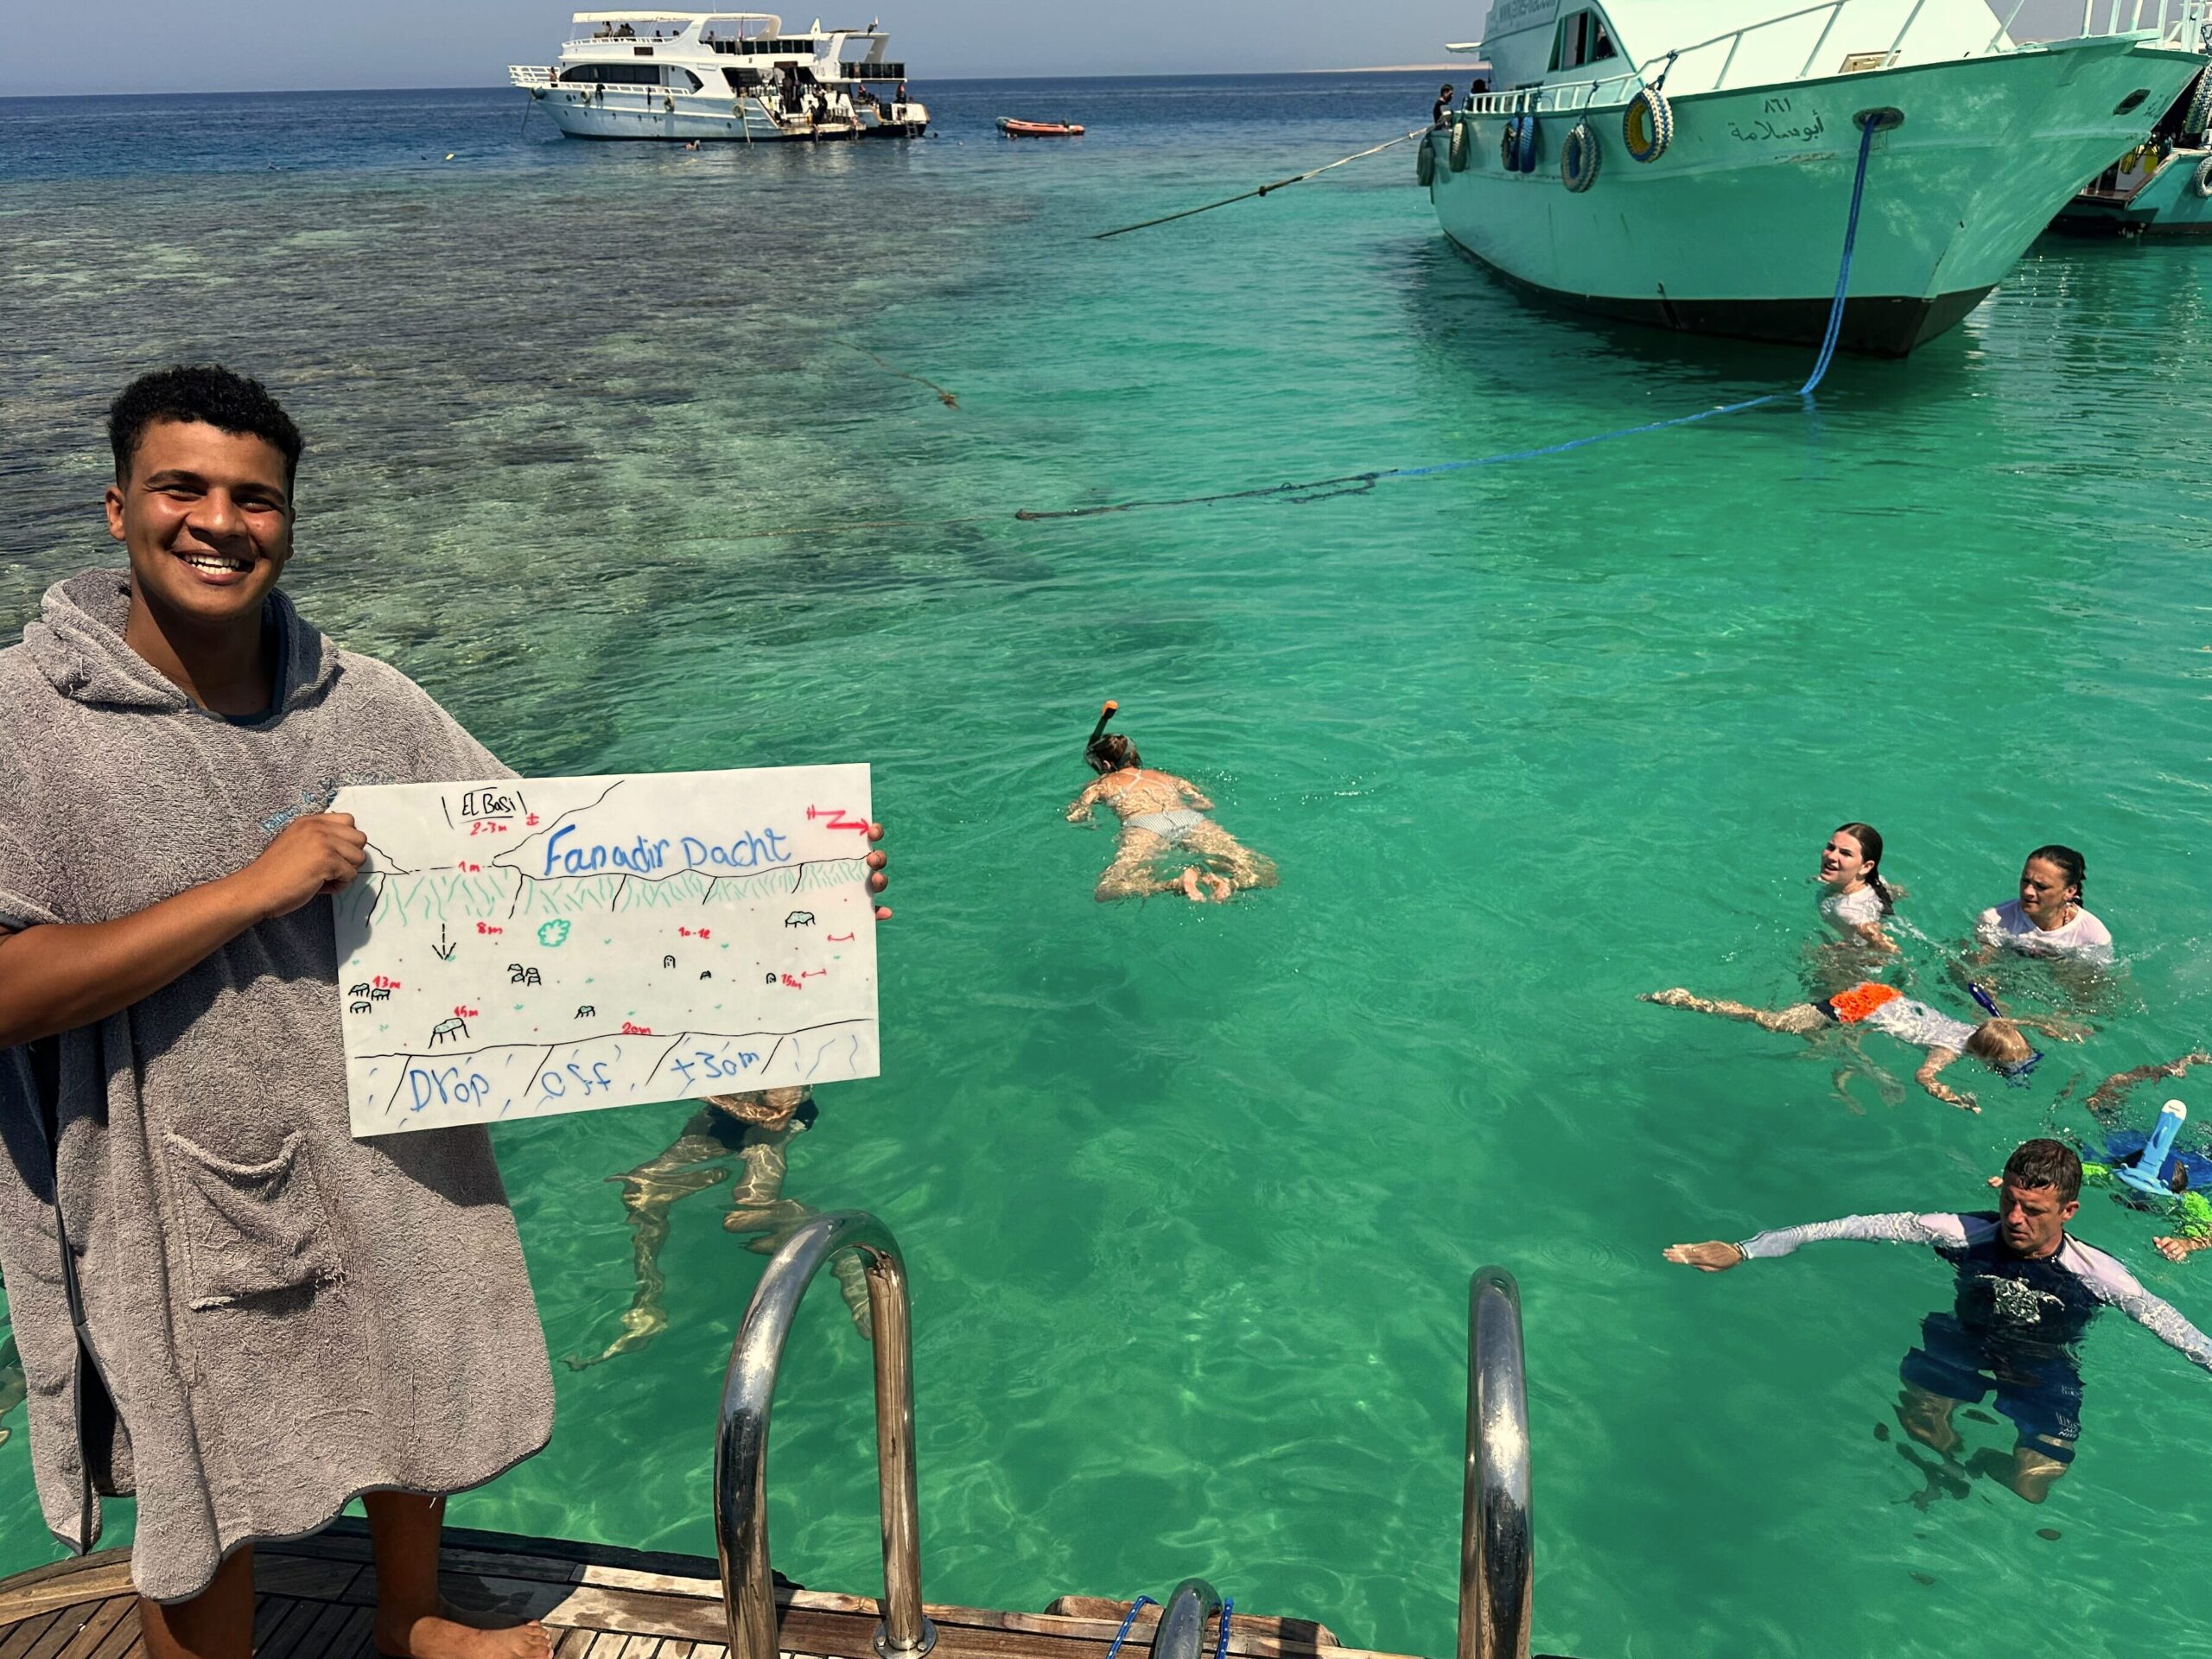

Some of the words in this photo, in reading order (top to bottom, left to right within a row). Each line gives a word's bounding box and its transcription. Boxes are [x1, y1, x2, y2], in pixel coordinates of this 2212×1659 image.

[543, 823, 671, 875] Fanadir
[680, 828, 792, 868] Dacht
[410, 1066, 490, 1113] Drop
